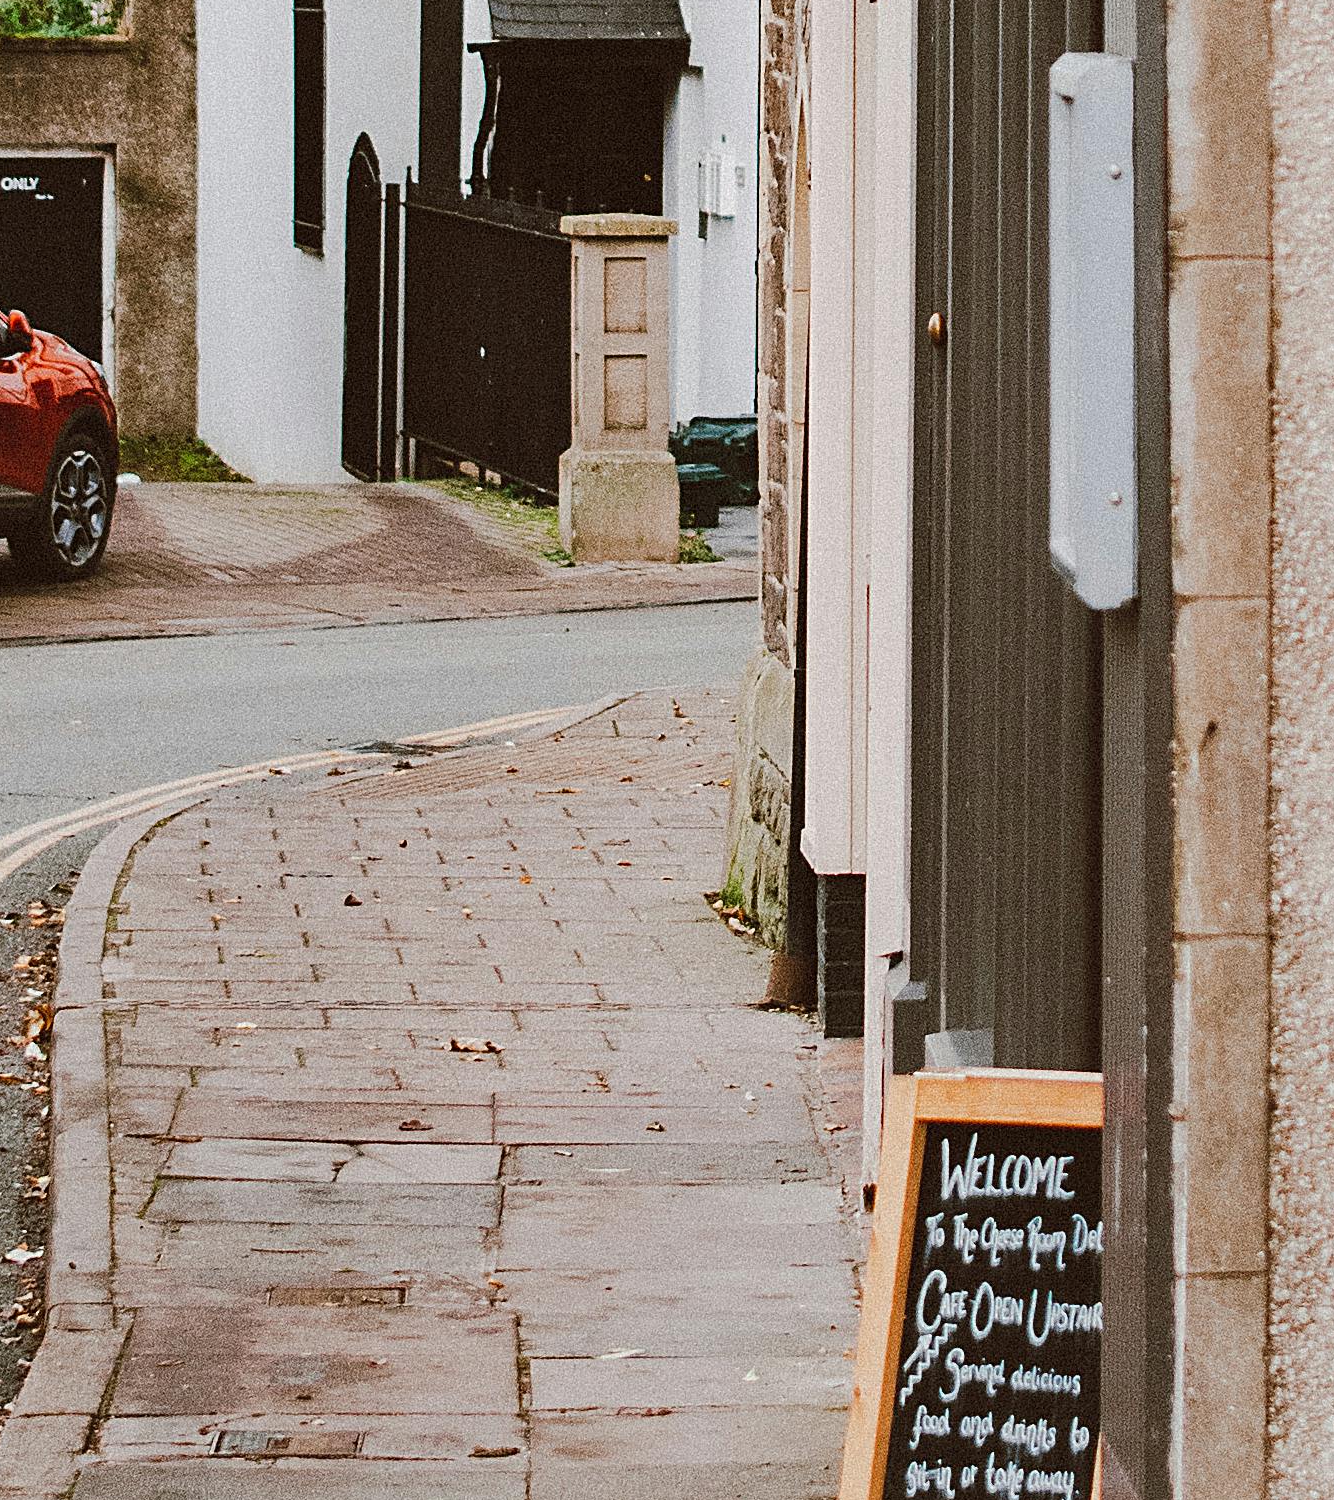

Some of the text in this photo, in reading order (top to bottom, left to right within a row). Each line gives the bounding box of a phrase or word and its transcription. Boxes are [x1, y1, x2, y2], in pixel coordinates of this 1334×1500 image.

[1, 177, 40, 191] ONLY
[940, 1132, 1075, 1200] WELCOME
[924, 1212, 945, 1254] To
[953, 1213, 979, 1264] The
[1027, 1216, 1066, 1269] Room
[1071, 1213, 1104, 1256] Del
[1027, 1288, 1104, 1346] UPSTAIR
[1010, 1363, 1081, 1398] delicious
[909, 1405, 1090, 1456] food and drinks to
[961, 1465, 978, 1488] or
